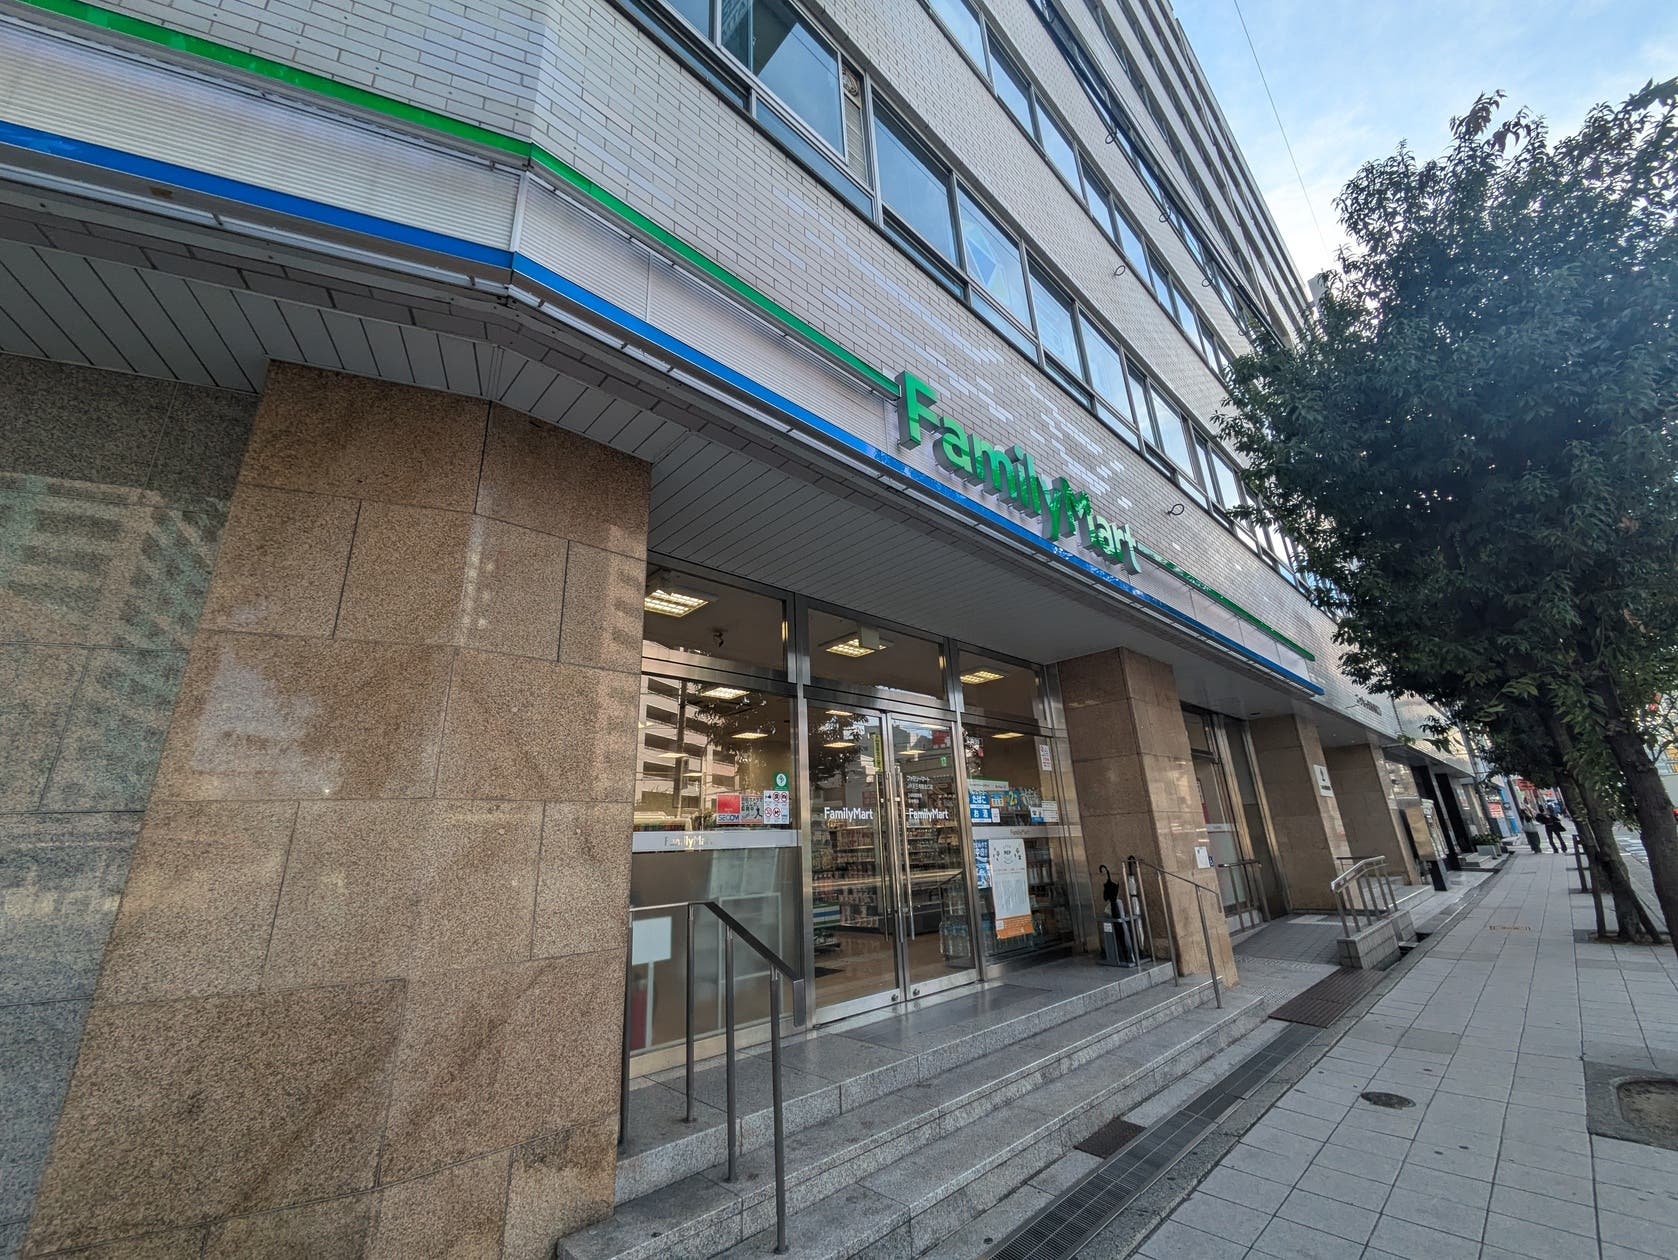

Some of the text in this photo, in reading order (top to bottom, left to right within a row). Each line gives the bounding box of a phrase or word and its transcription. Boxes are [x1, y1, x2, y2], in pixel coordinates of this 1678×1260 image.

[894, 369, 1142, 575] FamilyMart
[718, 814, 740, 822] SECOM
[823, 807, 873, 822] FamilyMart
[908, 808, 949, 822] FamilyMart
